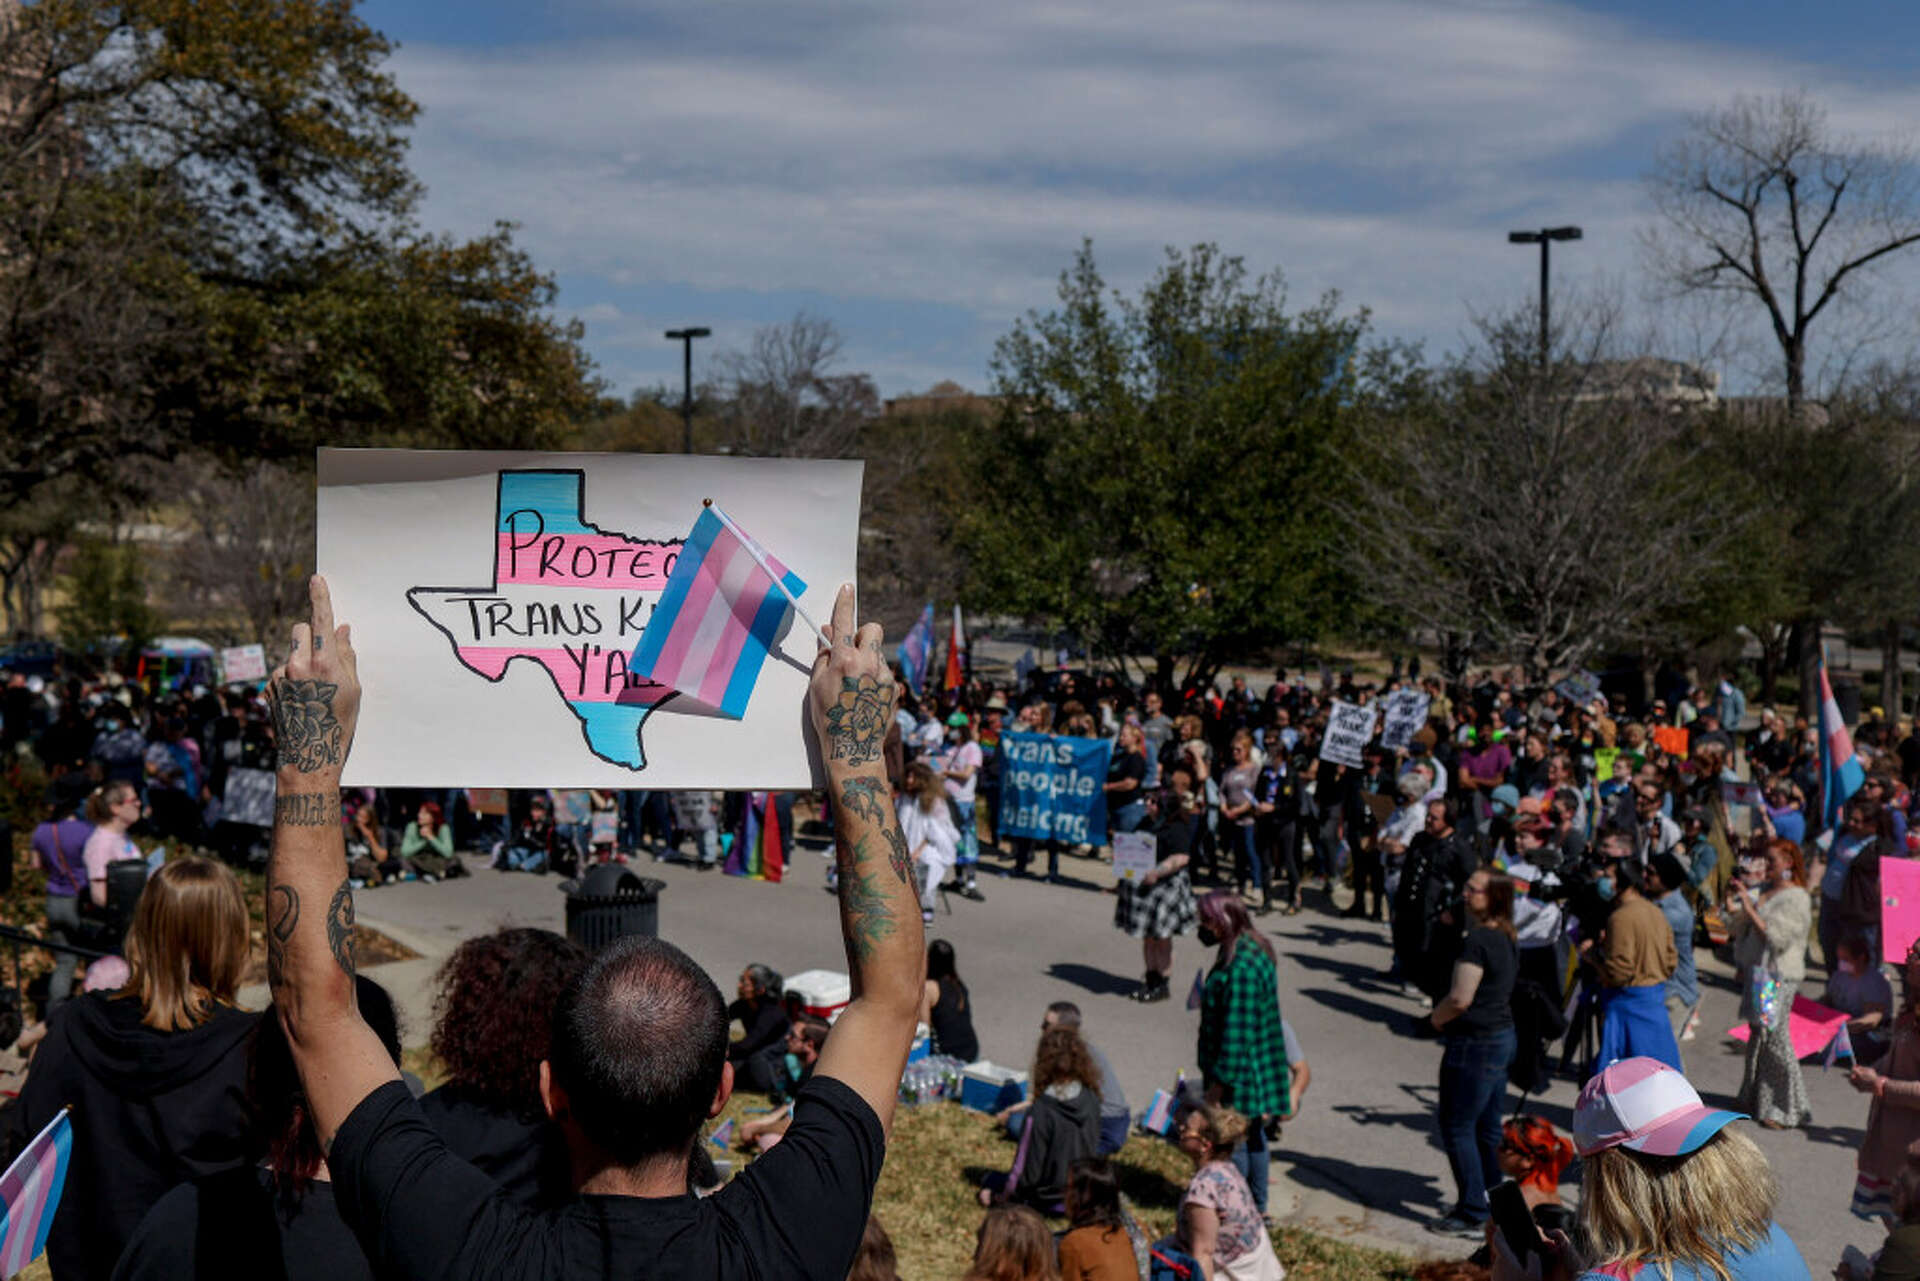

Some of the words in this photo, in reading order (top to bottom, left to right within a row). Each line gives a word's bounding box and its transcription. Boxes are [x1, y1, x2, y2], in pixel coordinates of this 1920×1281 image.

[505, 508, 678, 579] PROTEC
[444, 597, 602, 641] TRANS
[1004, 768, 1096, 800] people
